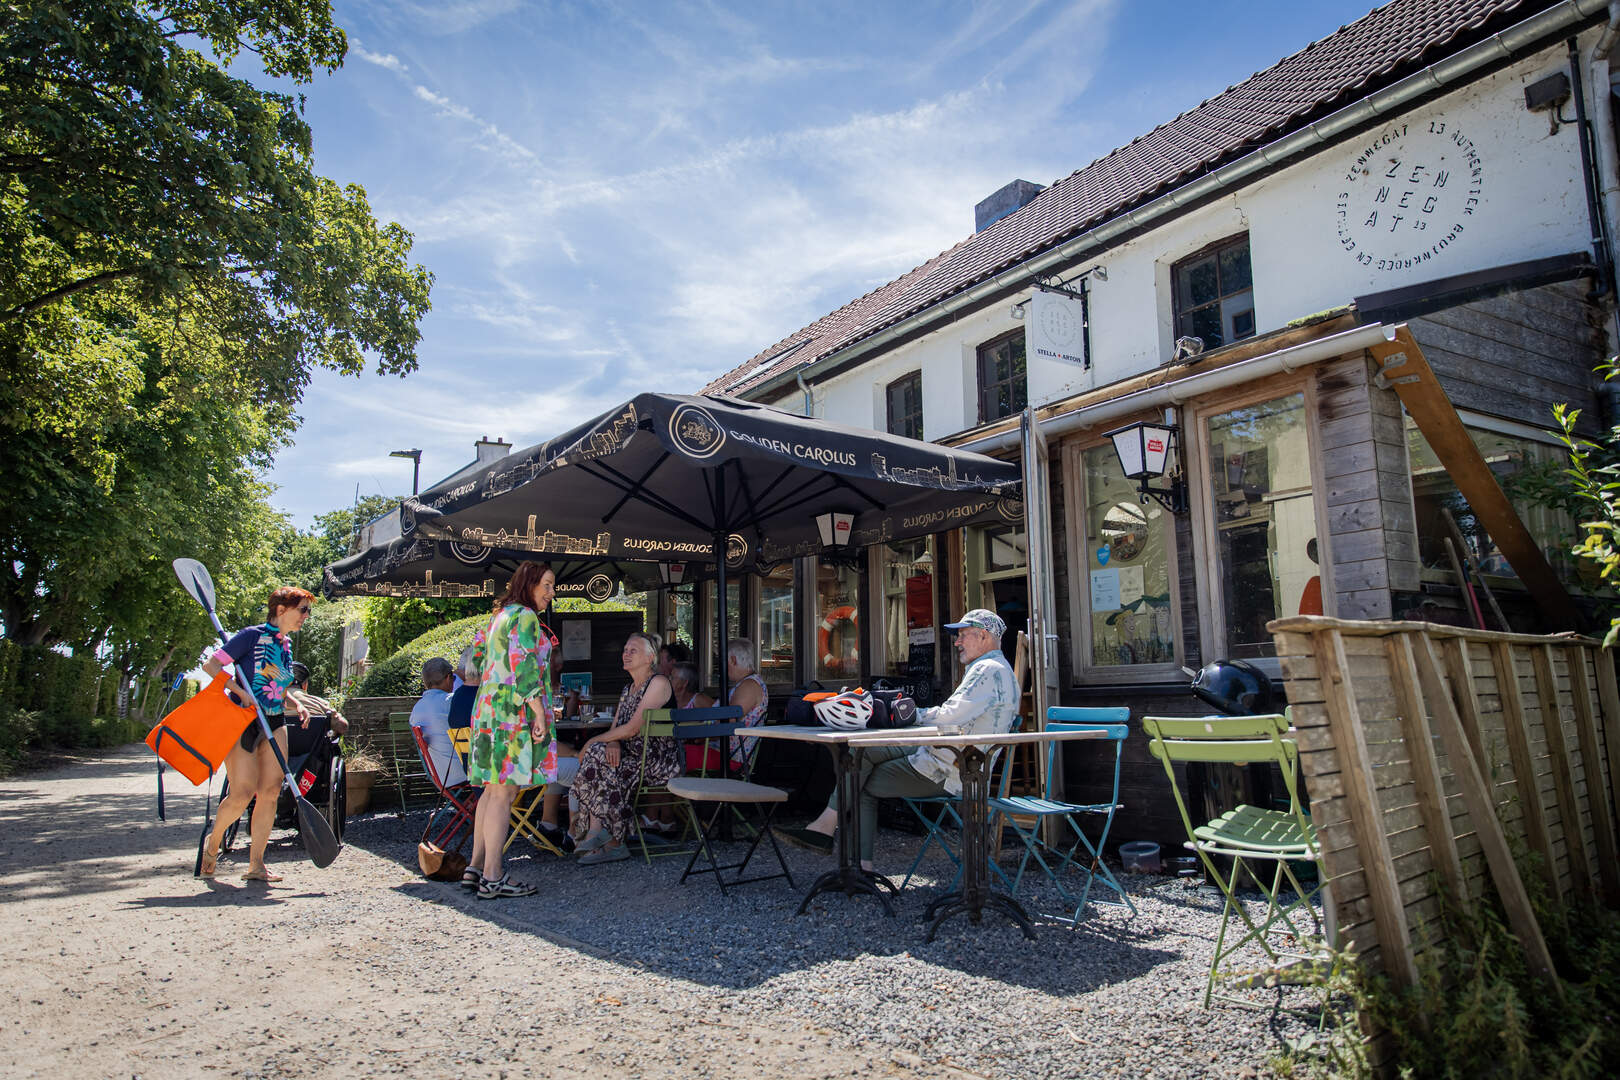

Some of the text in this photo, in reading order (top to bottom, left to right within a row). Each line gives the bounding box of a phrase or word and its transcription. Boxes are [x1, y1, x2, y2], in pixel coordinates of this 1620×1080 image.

[1428, 121, 1446, 135] 13
[1412, 219, 1427, 231] 13
[1037, 349, 1057, 358] STELLA
[729, 430, 857, 466] GOUDEN CAROLUS
